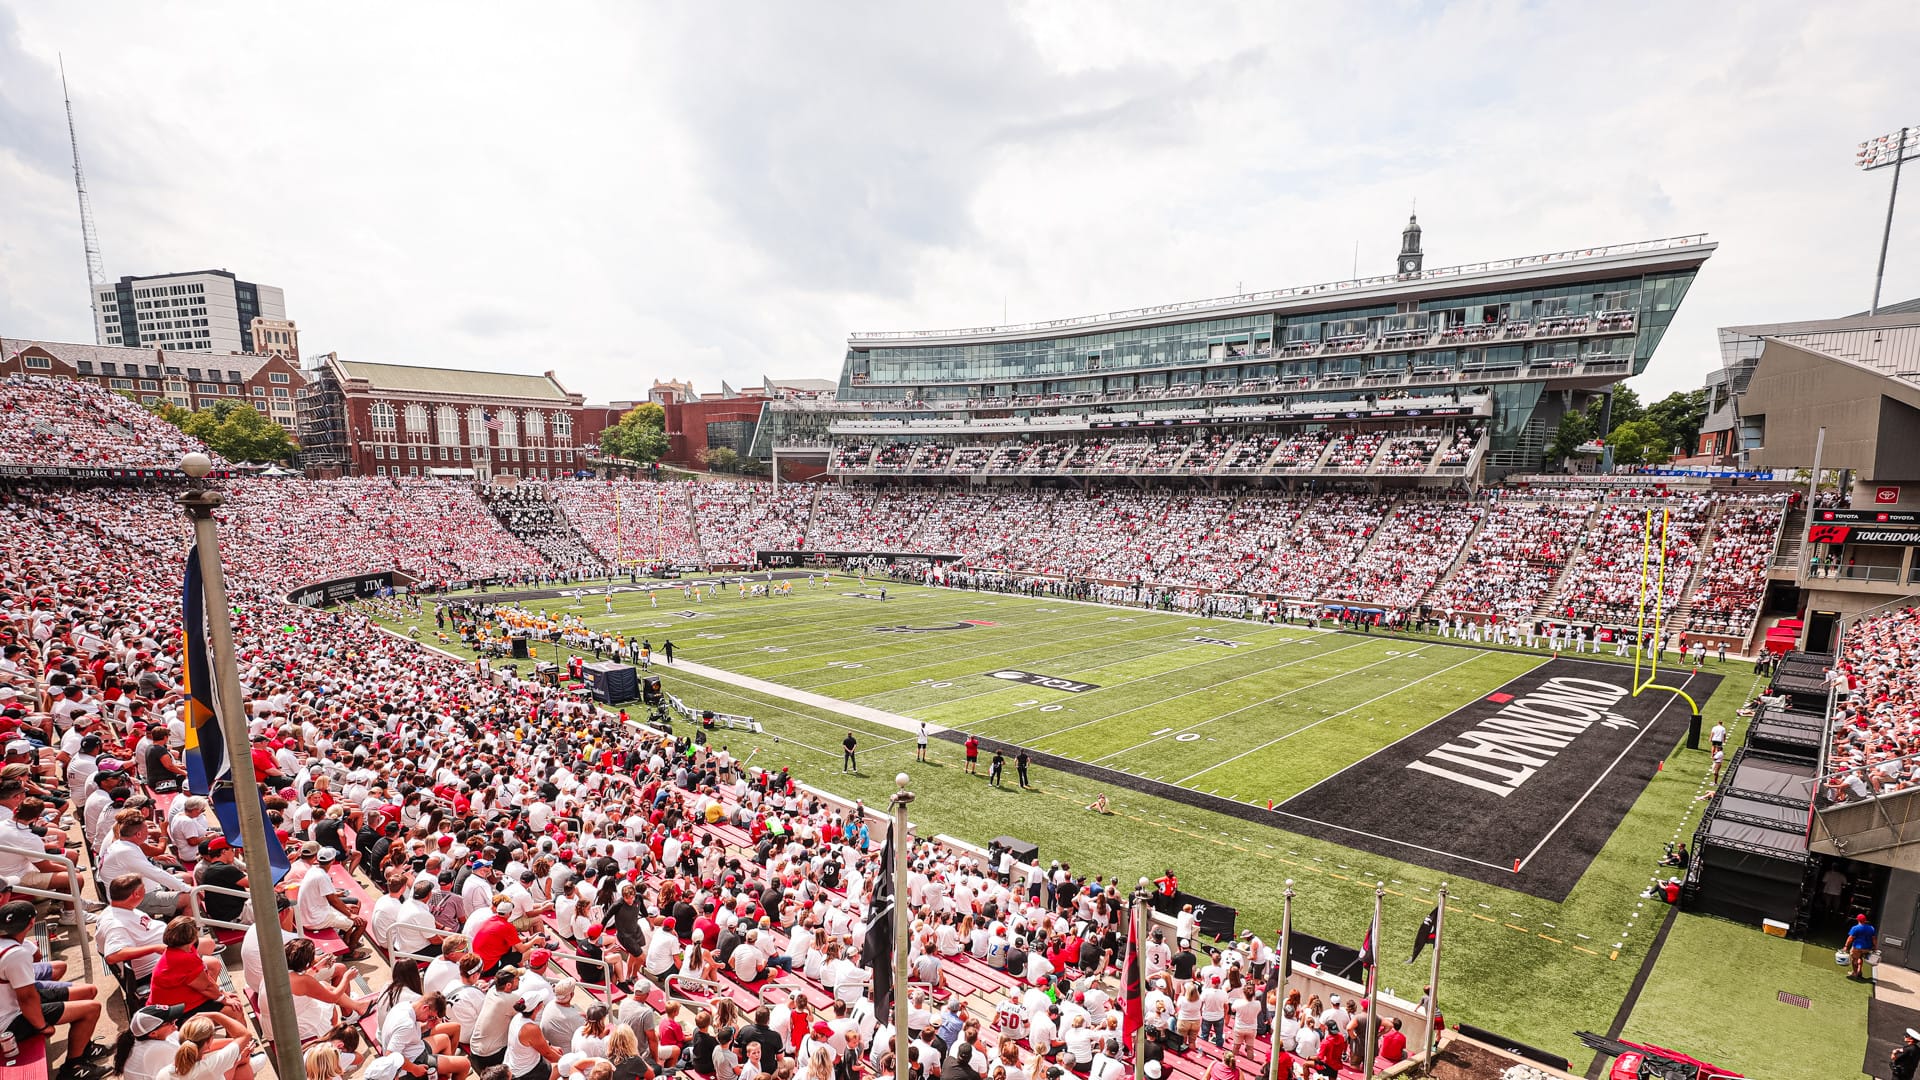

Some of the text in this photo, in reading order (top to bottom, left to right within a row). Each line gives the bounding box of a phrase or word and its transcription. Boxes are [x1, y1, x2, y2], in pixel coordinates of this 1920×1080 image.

[1856, 531, 1920, 543] TOUCHDOW
[846, 556, 887, 566] BEARCATS
[364, 579, 384, 592] JTM
[1150, 728, 1201, 742] 10
[1405, 677, 1629, 798] CINCINNATI
[824, 865, 835, 875] 49
[1153, 953, 1160, 965] 3
[1001, 1010, 1019, 1030] 50
